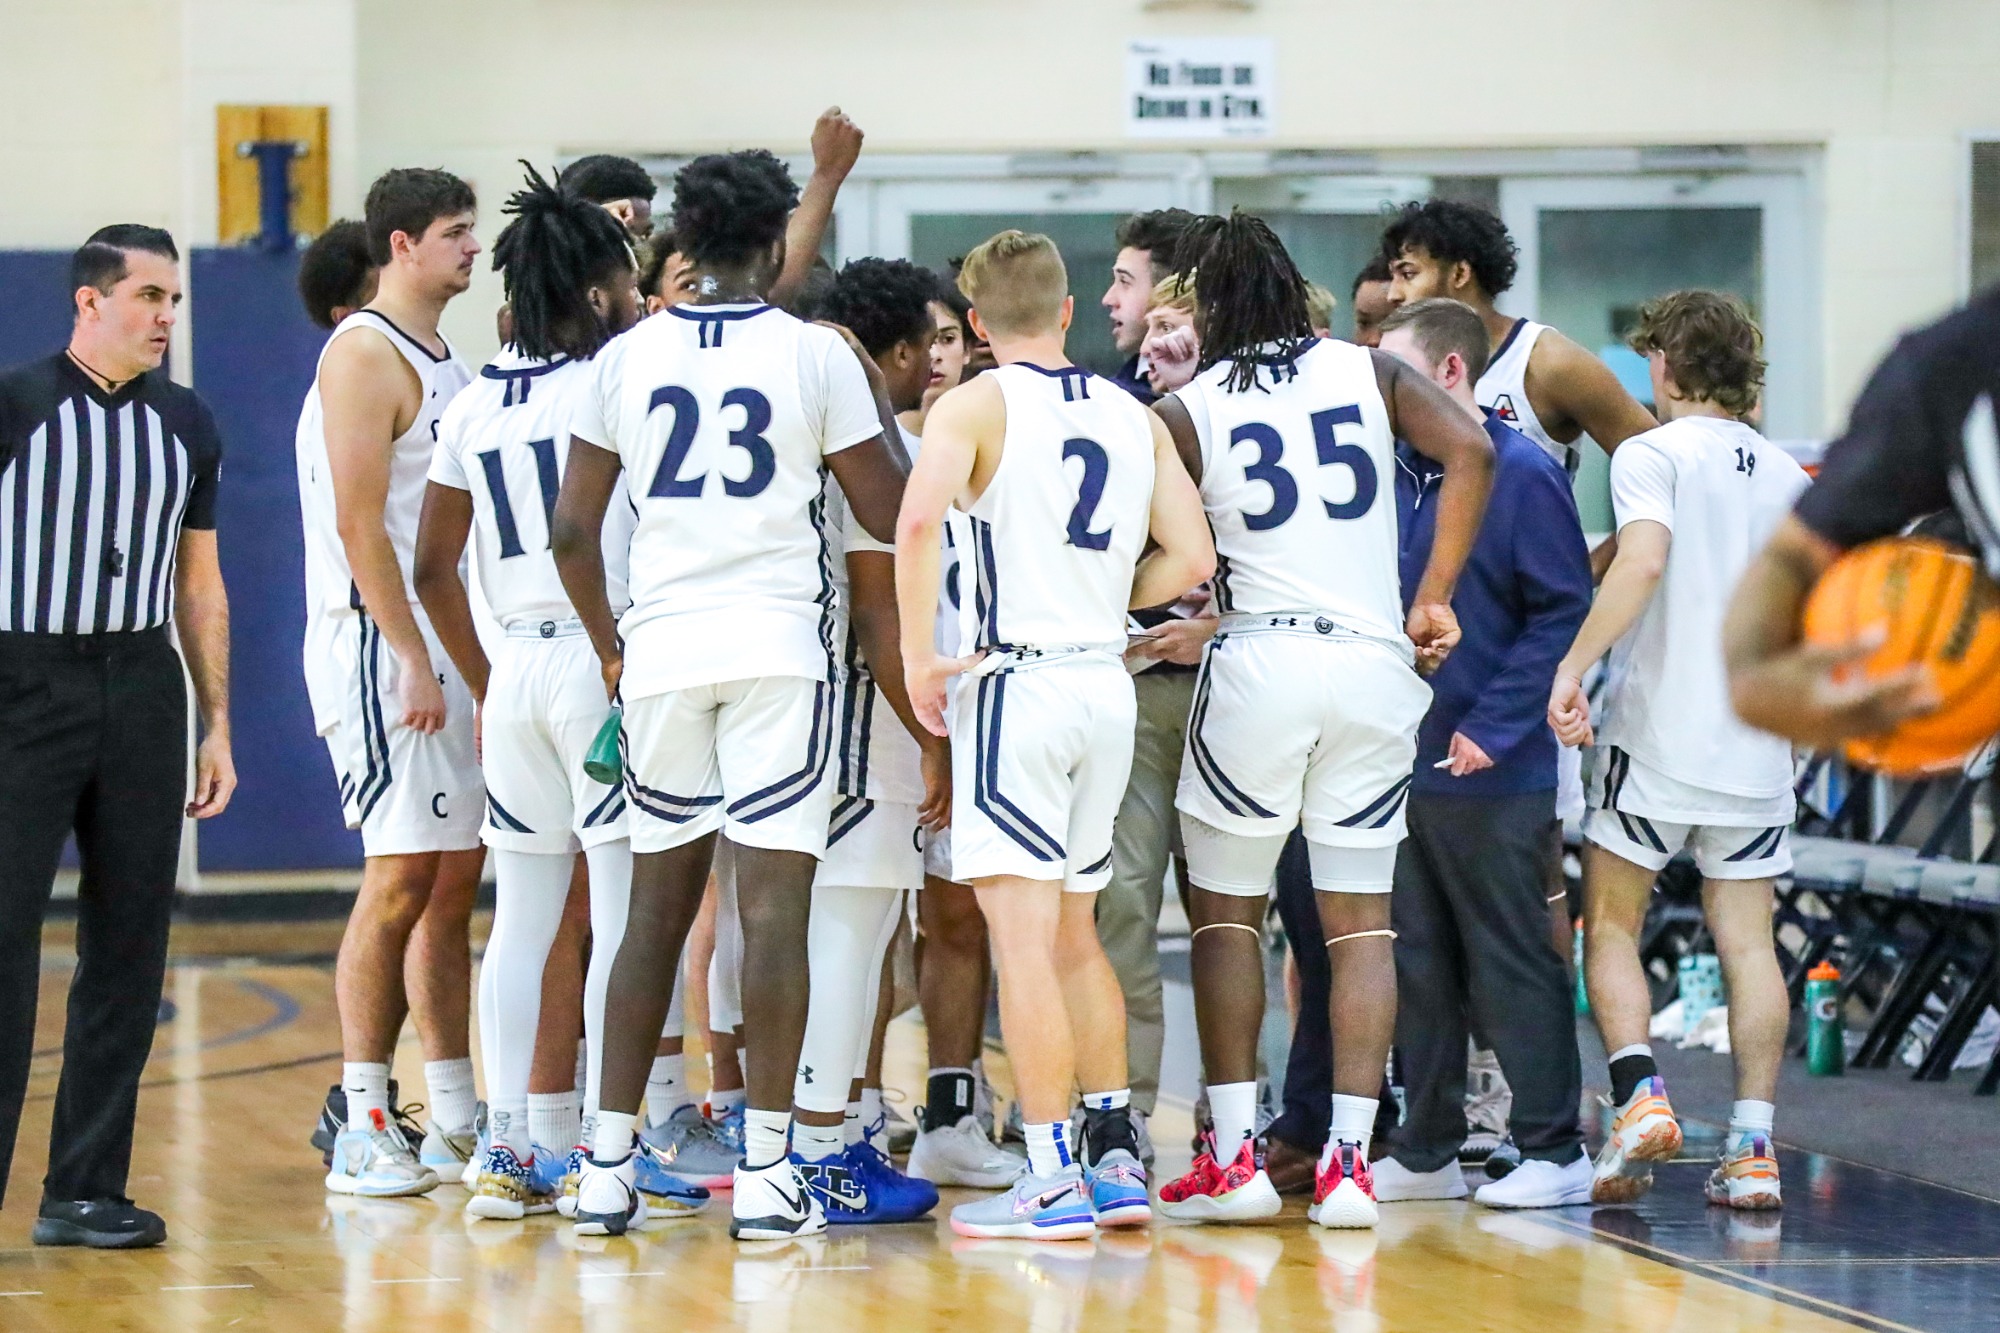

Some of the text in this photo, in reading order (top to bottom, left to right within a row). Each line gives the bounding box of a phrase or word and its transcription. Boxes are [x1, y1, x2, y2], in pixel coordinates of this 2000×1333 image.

[474, 434, 561, 560] 11
[645, 382, 778, 500] 23
[1061, 434, 1116, 552] 2
[1238, 402, 1379, 533] 35
[432, 792, 448, 819] C
